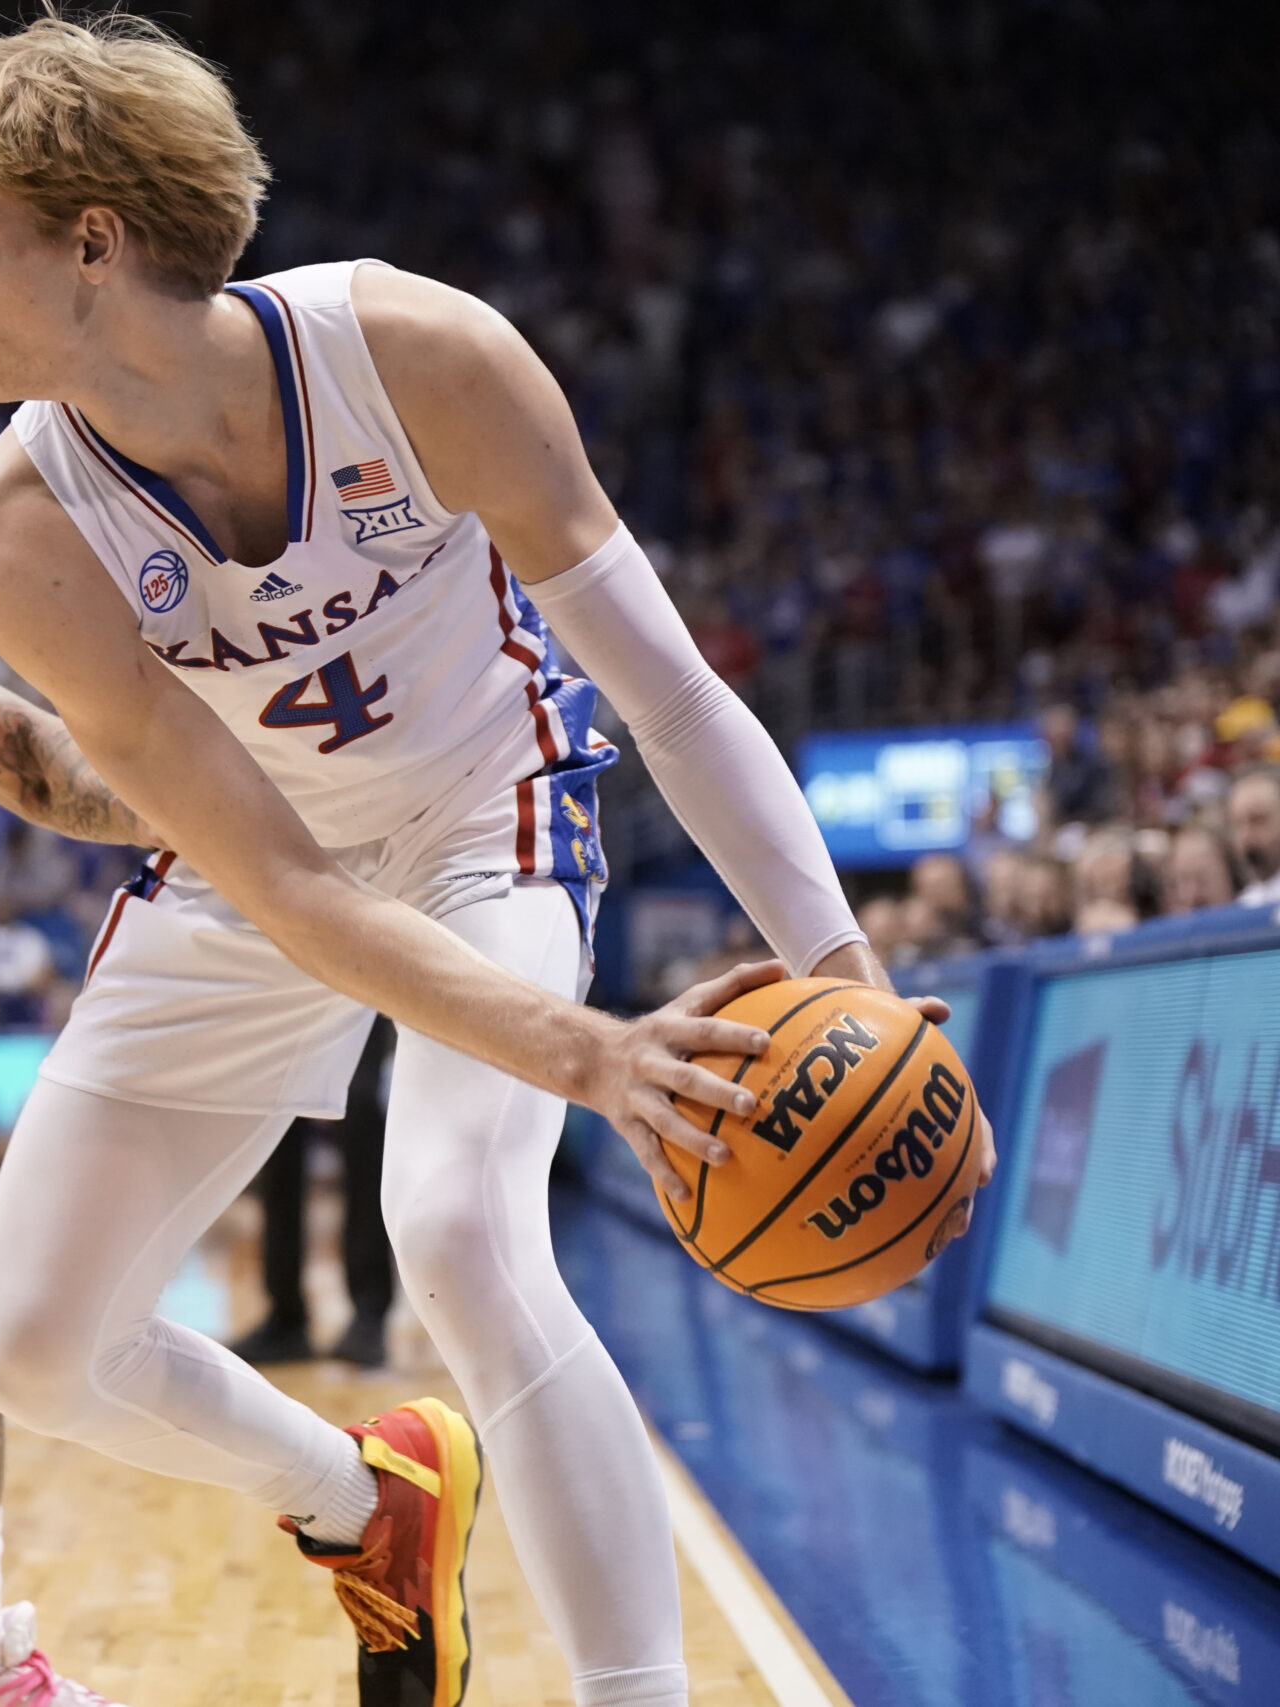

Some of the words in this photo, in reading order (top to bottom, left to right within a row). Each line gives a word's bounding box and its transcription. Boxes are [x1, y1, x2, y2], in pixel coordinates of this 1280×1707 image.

[340, 495, 426, 544] XII
[143, 572, 169, 603] 125
[144, 542, 447, 672] KANSA
[249, 583, 304, 602] adidas
[259, 651, 394, 755] 4
[751, 1012, 881, 1154] NCAA
[806, 1062, 966, 1240] Wilson
